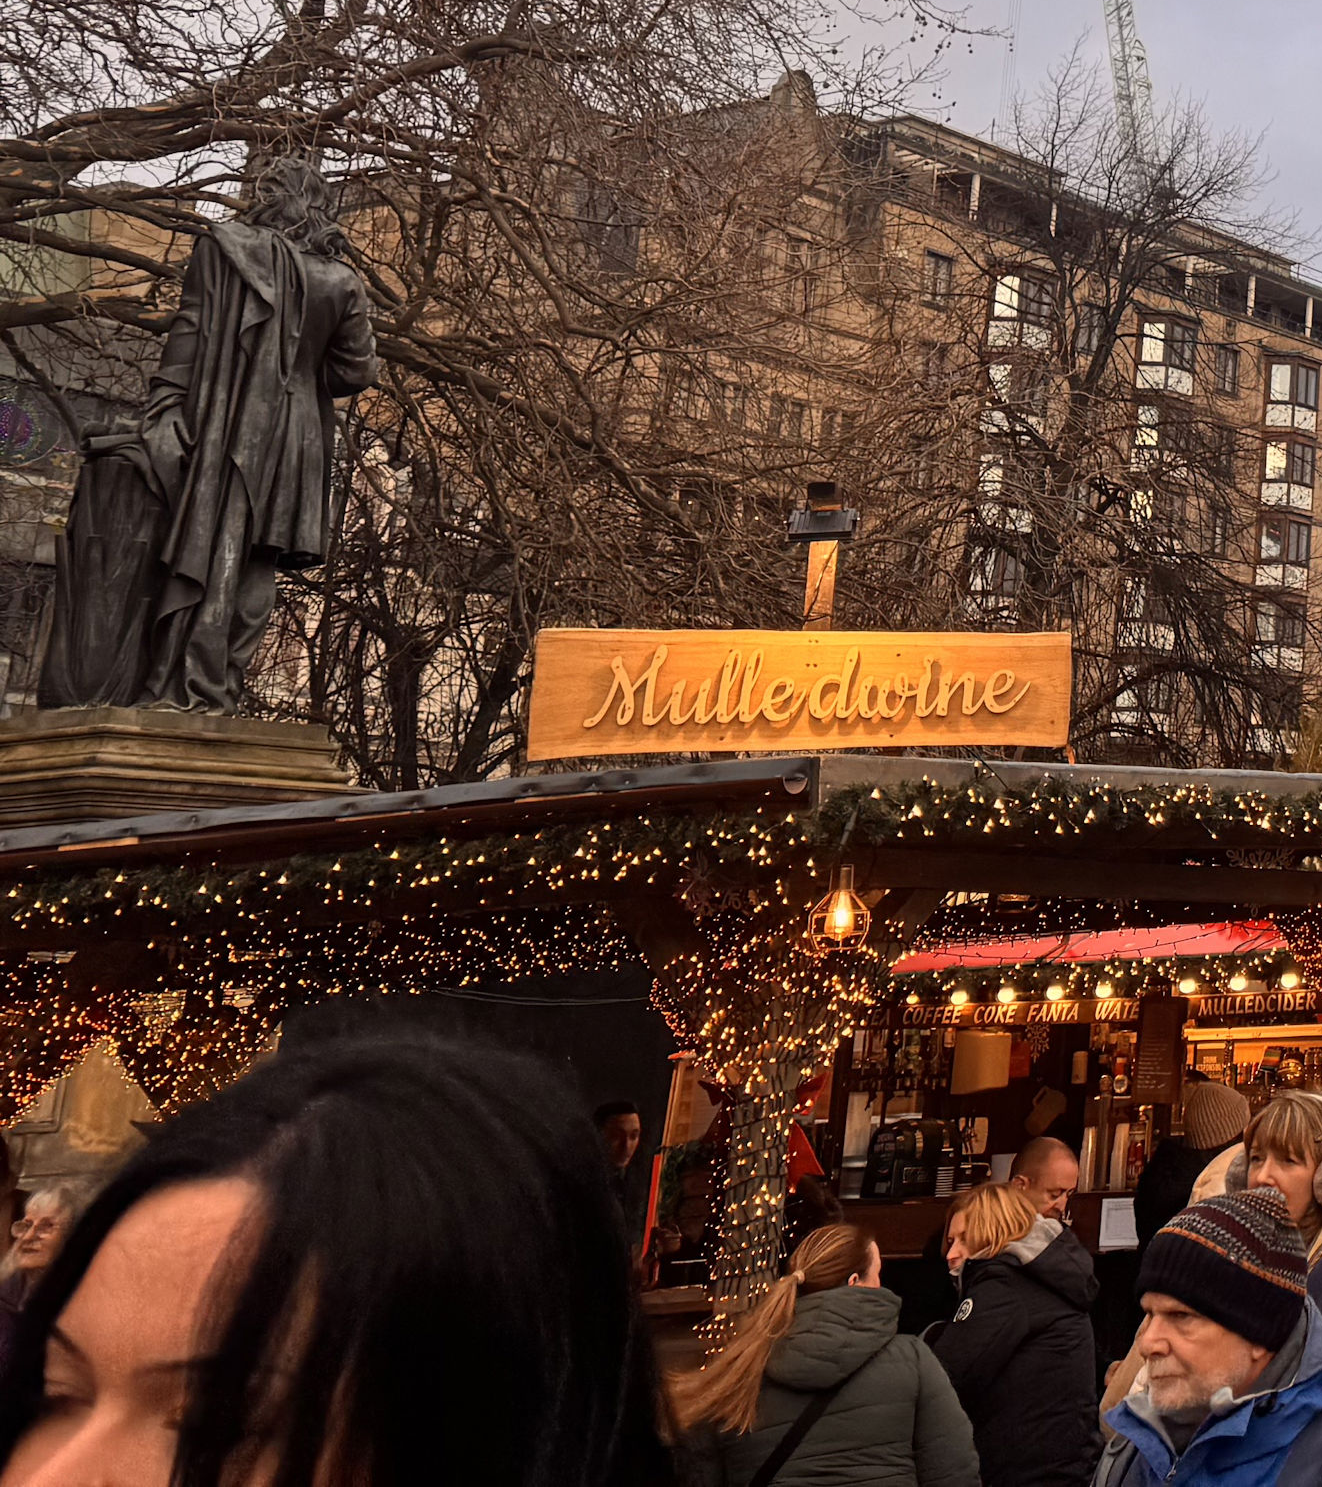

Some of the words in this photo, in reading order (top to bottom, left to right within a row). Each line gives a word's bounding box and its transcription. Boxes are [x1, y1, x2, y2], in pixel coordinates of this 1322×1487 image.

[902, 1005, 963, 1025] COFFEE
[973, 1004, 1017, 1024] COKE
[1027, 1002, 1080, 1022] FANTA
[1095, 1001, 1140, 1021] WATE
